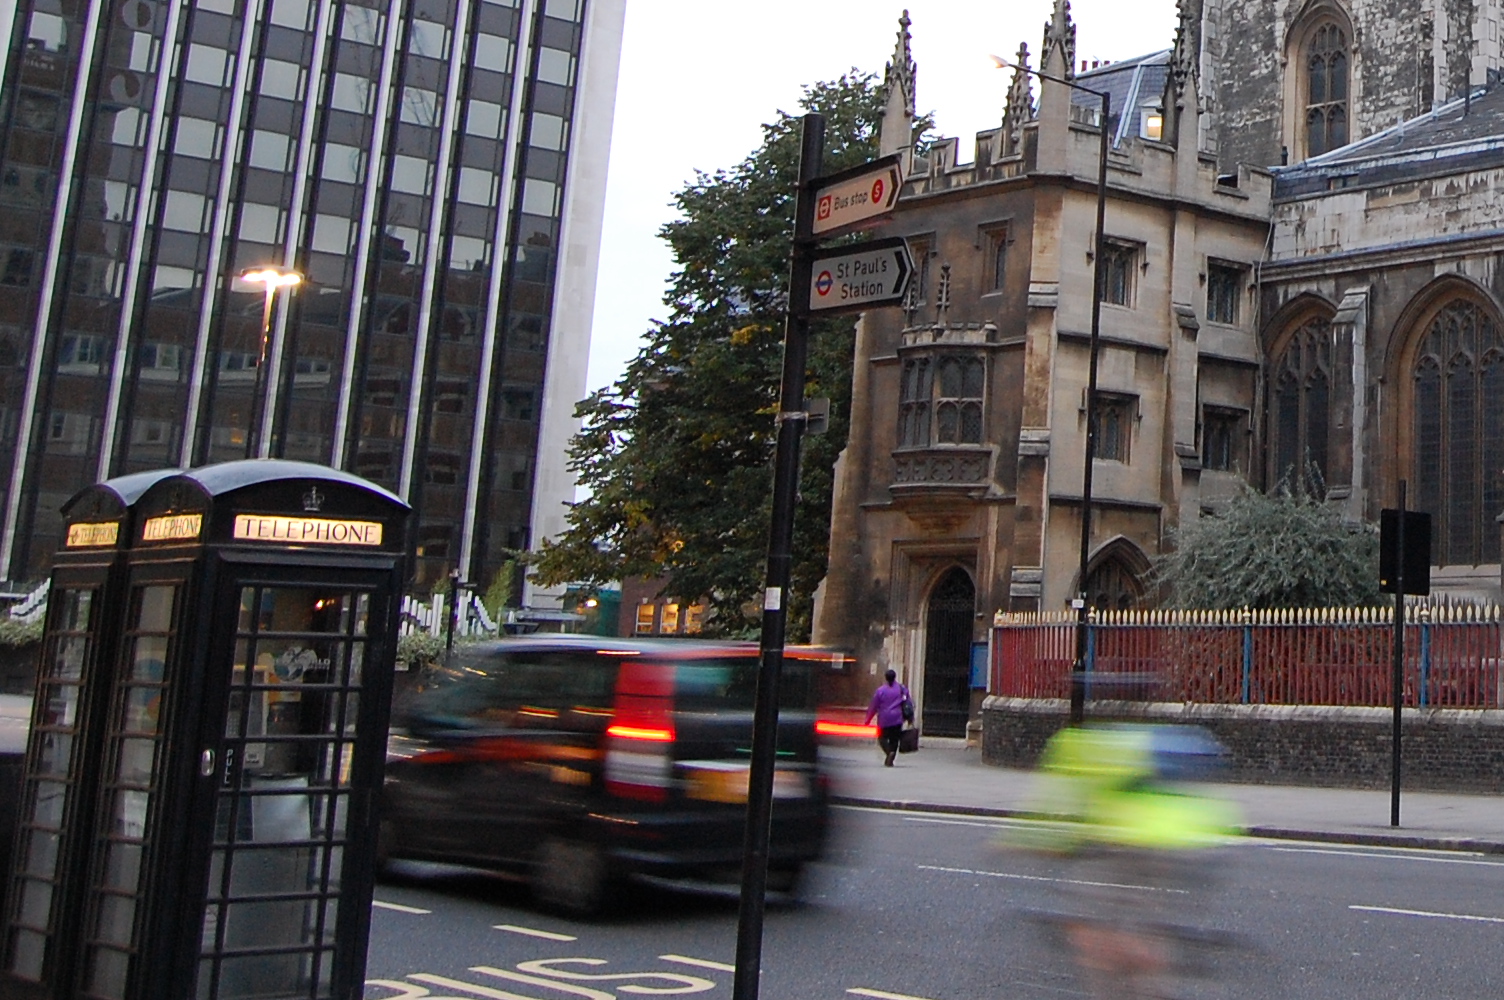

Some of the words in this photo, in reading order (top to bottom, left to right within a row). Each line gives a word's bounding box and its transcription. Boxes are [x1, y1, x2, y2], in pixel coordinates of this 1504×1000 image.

[834, 196, 849, 210] Bus
[850, 191, 869, 206] stop
[837, 262, 850, 279] St
[854, 257, 887, 276] Paul's
[841, 281, 883, 299] Station
[81, 527, 116, 543] TELEPHON
[148, 516, 200, 537] TELEPHONE
[242, 518, 377, 543] TELEPHONE
[224, 748, 234, 784] PULL
